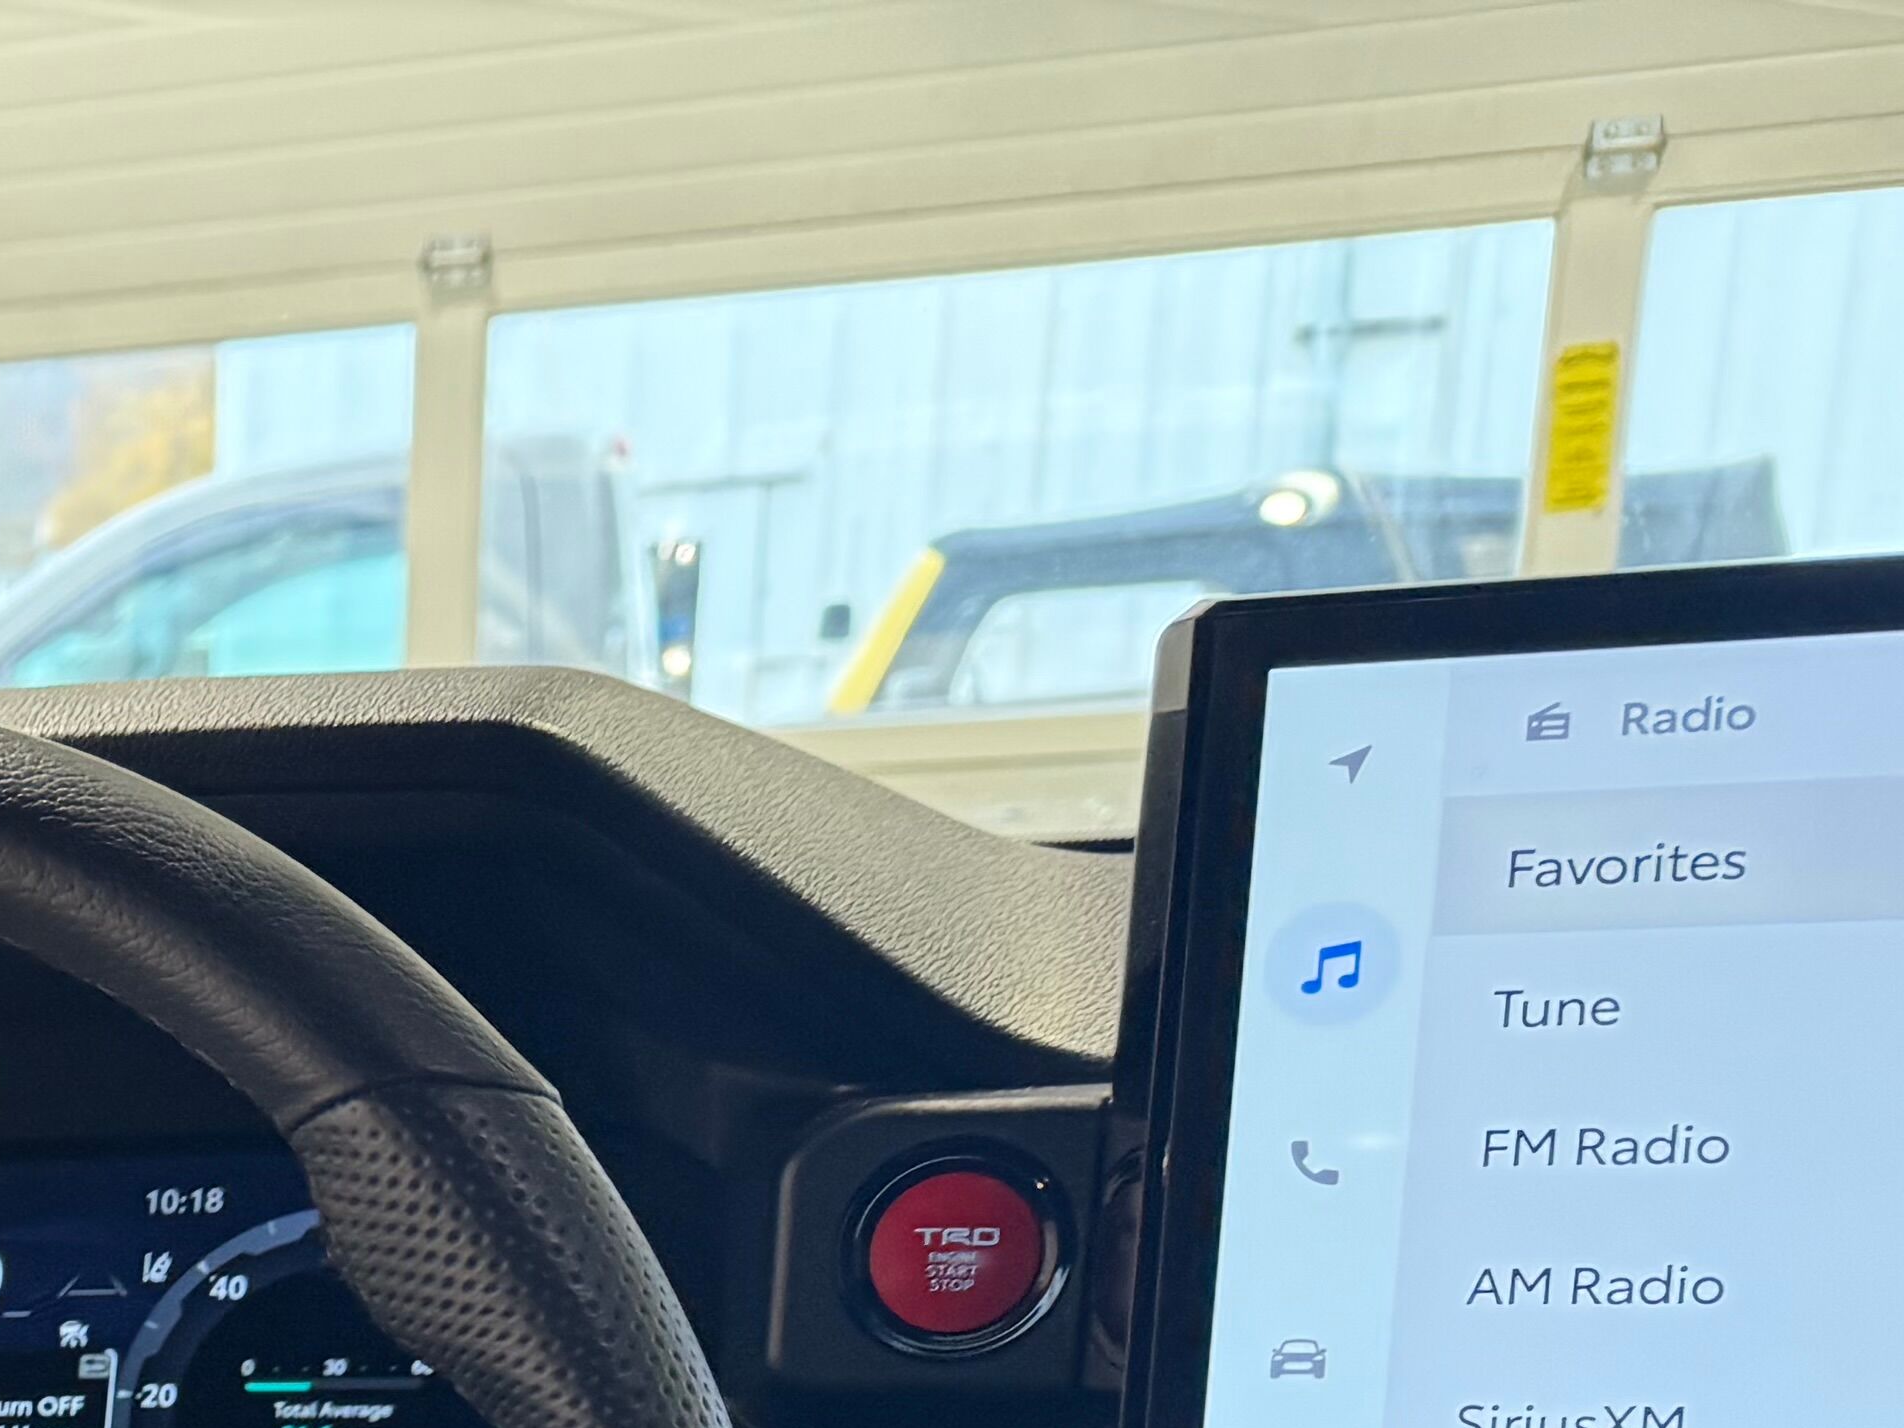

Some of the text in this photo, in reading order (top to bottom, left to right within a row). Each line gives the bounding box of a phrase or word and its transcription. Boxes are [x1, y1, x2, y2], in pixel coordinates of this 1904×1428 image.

[1621, 696, 1756, 736] Radio
[1507, 843, 1747, 888] Favorites
[1494, 988, 1621, 1030] Tune
[1482, 1124, 1730, 1167] FM Radio
[146, 1187, 224, 1215] 10:18
[914, 1227, 1001, 1246] TRD
[209, 1274, 249, 1301] 40
[929, 1278, 975, 1292] STOP
[1466, 1264, 1725, 1306] AM Radio
[241, 1359, 256, 1376] 0
[322, 1359, 348, 1376] 30
[37, 1395, 86, 1417] OFF
[139, 1383, 177, 1408] 20
[273, 1402, 394, 1423] Total Average
